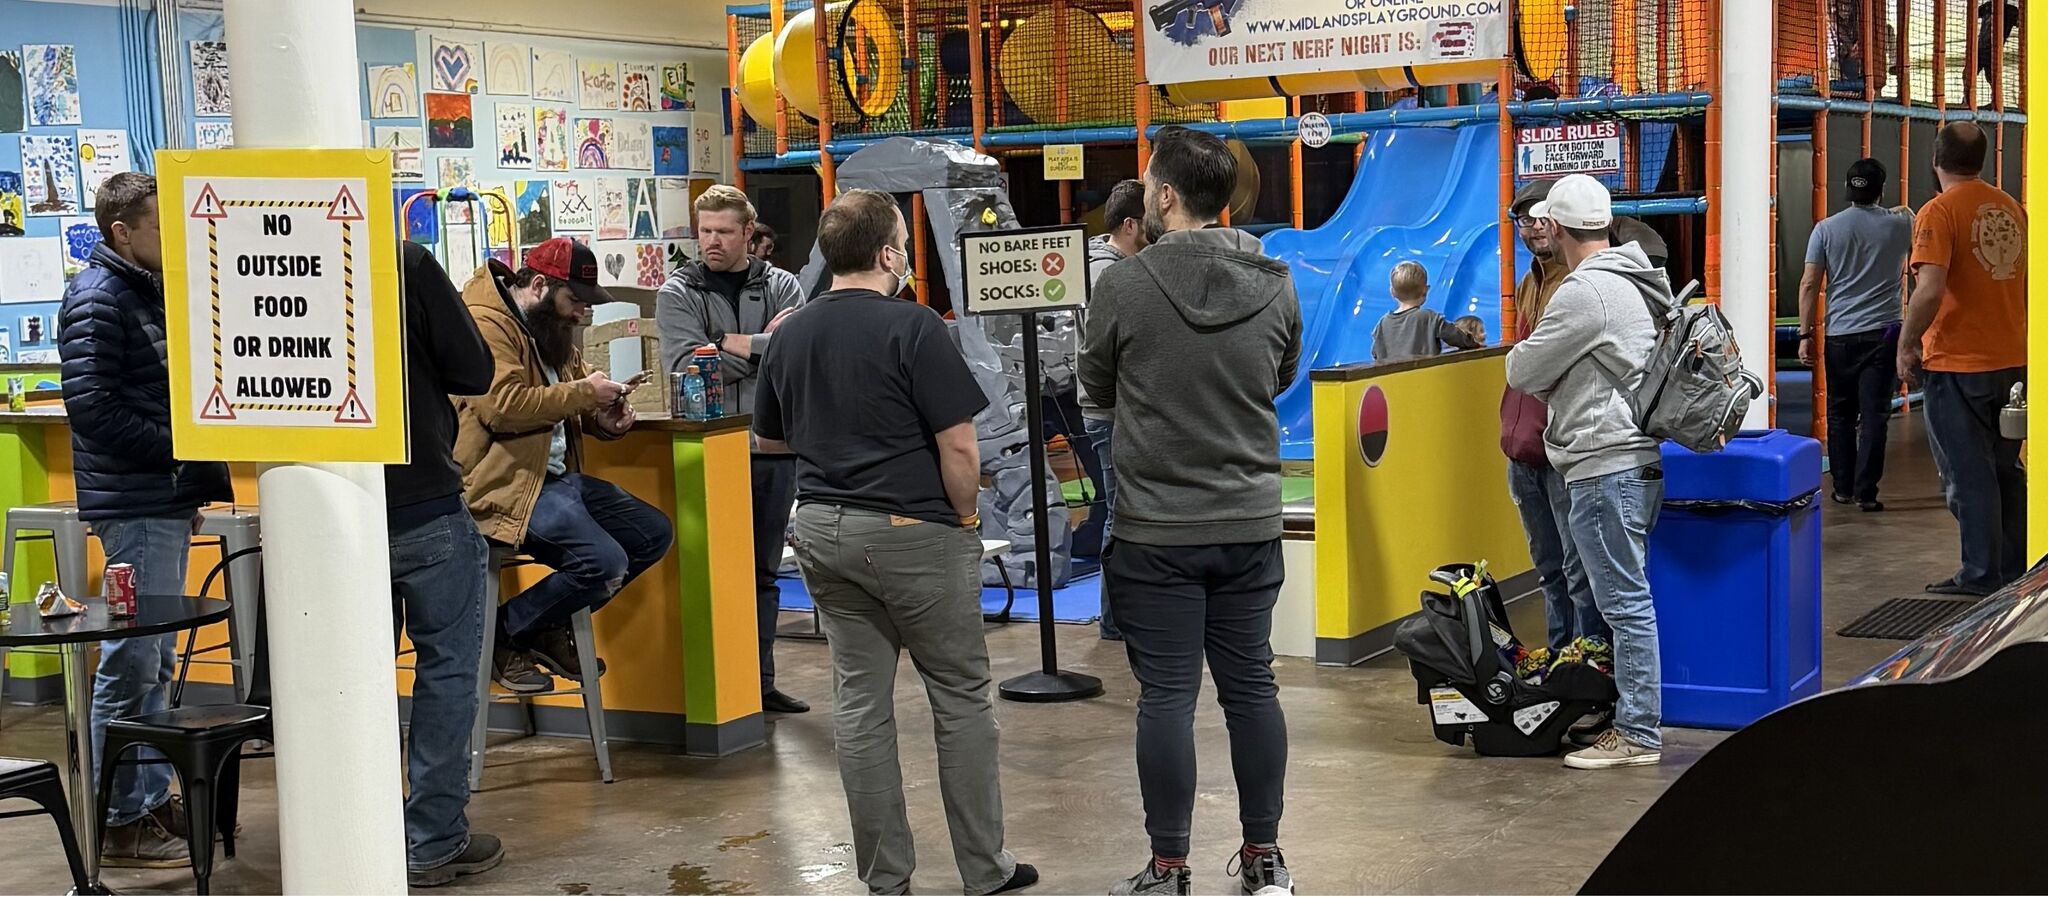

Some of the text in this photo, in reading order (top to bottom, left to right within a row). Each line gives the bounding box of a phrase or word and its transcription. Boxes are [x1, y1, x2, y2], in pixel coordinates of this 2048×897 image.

[1246, 2, 1501, 34] WWW.MIDLANDSPLAYGROUND.COM
[1208, 46, 1239, 67] OUR
[1245, 41, 1287, 64] NEXT
[1292, 38, 1335, 60] NERF
[1341, 32, 1392, 57] NIGHT
[1398, 30, 1421, 52] IS:
[1521, 123, 1616, 143] SLIDE RULES
[1545, 140, 1604, 154] SIT ON BOTTOM
[1545, 150, 1604, 162] FACE FORWARD
[1533, 159, 1617, 172] NO CLIMBING UP SLIDES
[263, 214, 292, 236] NO
[979, 236, 1072, 254] NO BARE FEET
[237, 254, 322, 277] OUTSIDE
[979, 258, 1037, 276] SHOES:
[979, 284, 1040, 301] SOCKS:
[254, 295, 308, 318] FOOD
[233, 335, 332, 358] OR DRINK
[236, 376, 332, 399] ALLOWED
